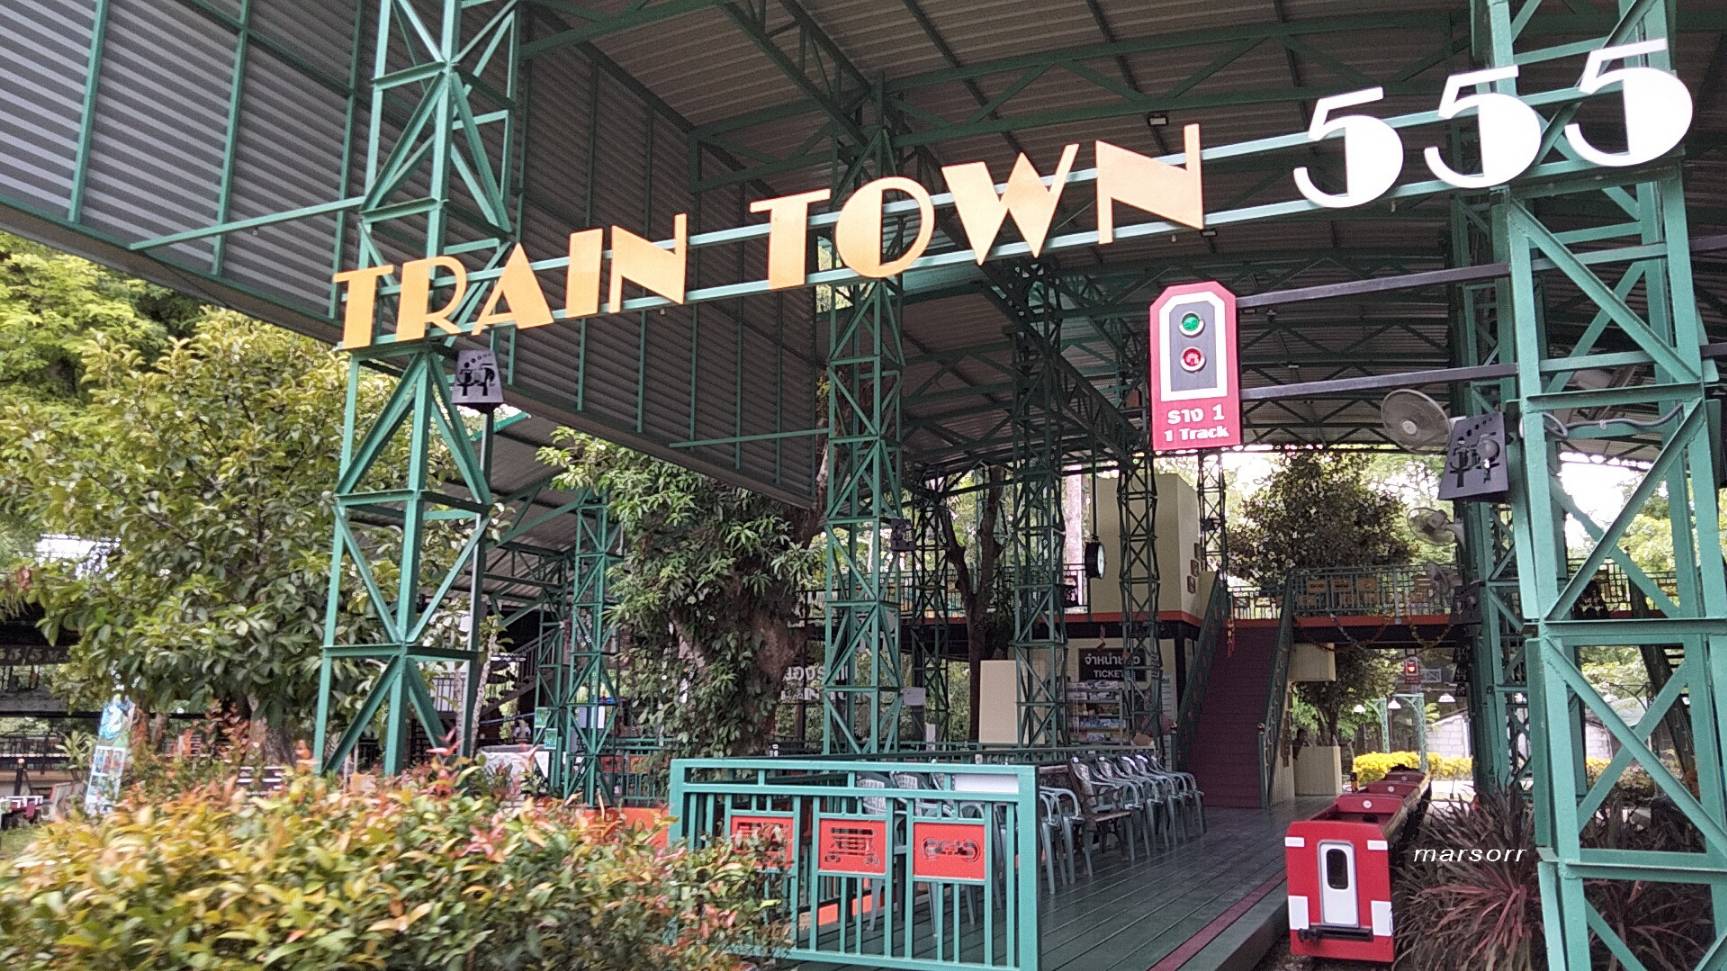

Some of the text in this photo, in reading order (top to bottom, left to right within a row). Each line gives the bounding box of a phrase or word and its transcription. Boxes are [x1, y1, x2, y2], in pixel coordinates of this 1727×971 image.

[333, 39, 1693, 349] TRAIN TOWN 555
[1167, 403, 1225, 425] ราง 1
[1163, 425, 1229, 442] 1 Track
